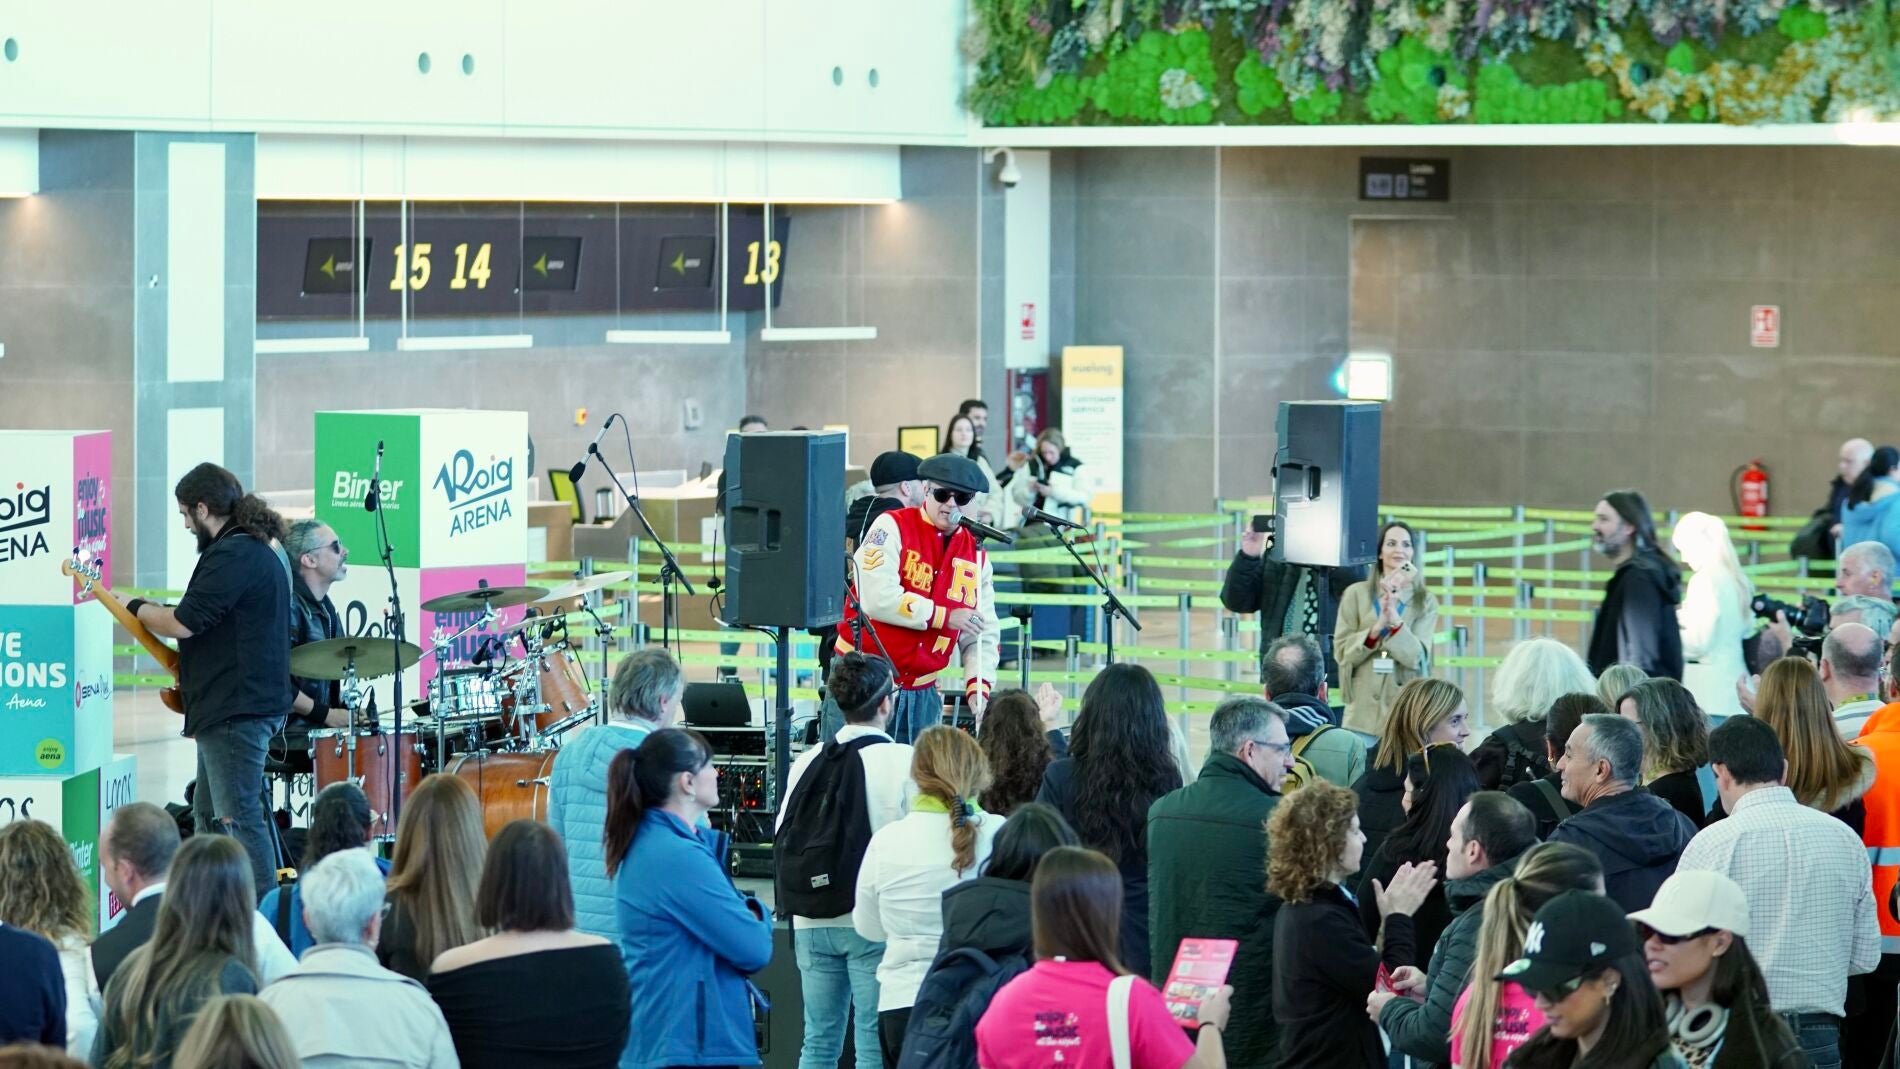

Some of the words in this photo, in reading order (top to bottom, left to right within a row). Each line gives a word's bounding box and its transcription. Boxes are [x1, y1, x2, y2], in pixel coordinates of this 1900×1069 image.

[390, 243, 431, 290] 15
[450, 243, 491, 289] 14
[743, 240, 781, 285] 13
[332, 471, 403, 501] Biner
[433, 449, 513, 507] Roig
[450, 498, 512, 537] ARENA
[947, 557, 978, 608] R
[0, 632, 22, 658] E
[6, 693, 46, 710] Aena
